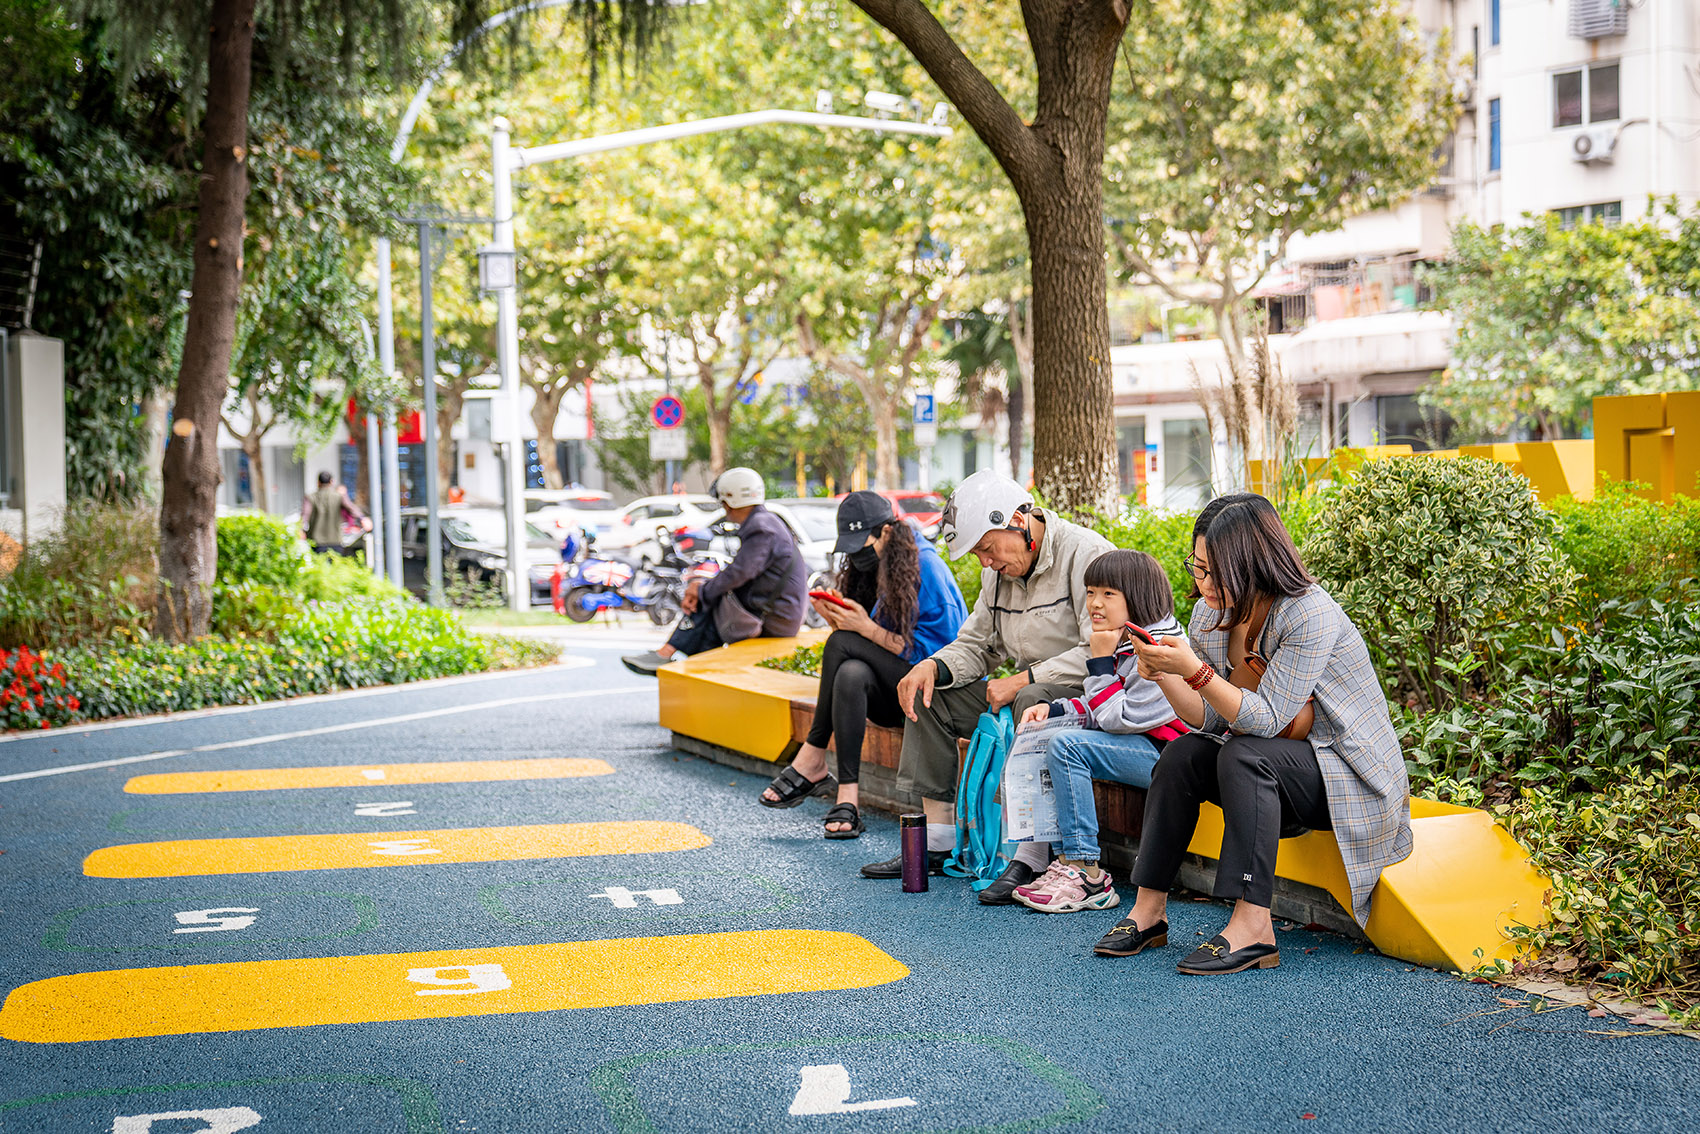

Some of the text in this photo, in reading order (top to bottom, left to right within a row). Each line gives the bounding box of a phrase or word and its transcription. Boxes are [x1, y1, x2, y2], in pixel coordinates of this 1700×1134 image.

[589, 886, 685, 909] 4
[173, 907, 260, 935] 5
[406, 963, 513, 997] 6
[787, 1063, 918, 1117] 7
